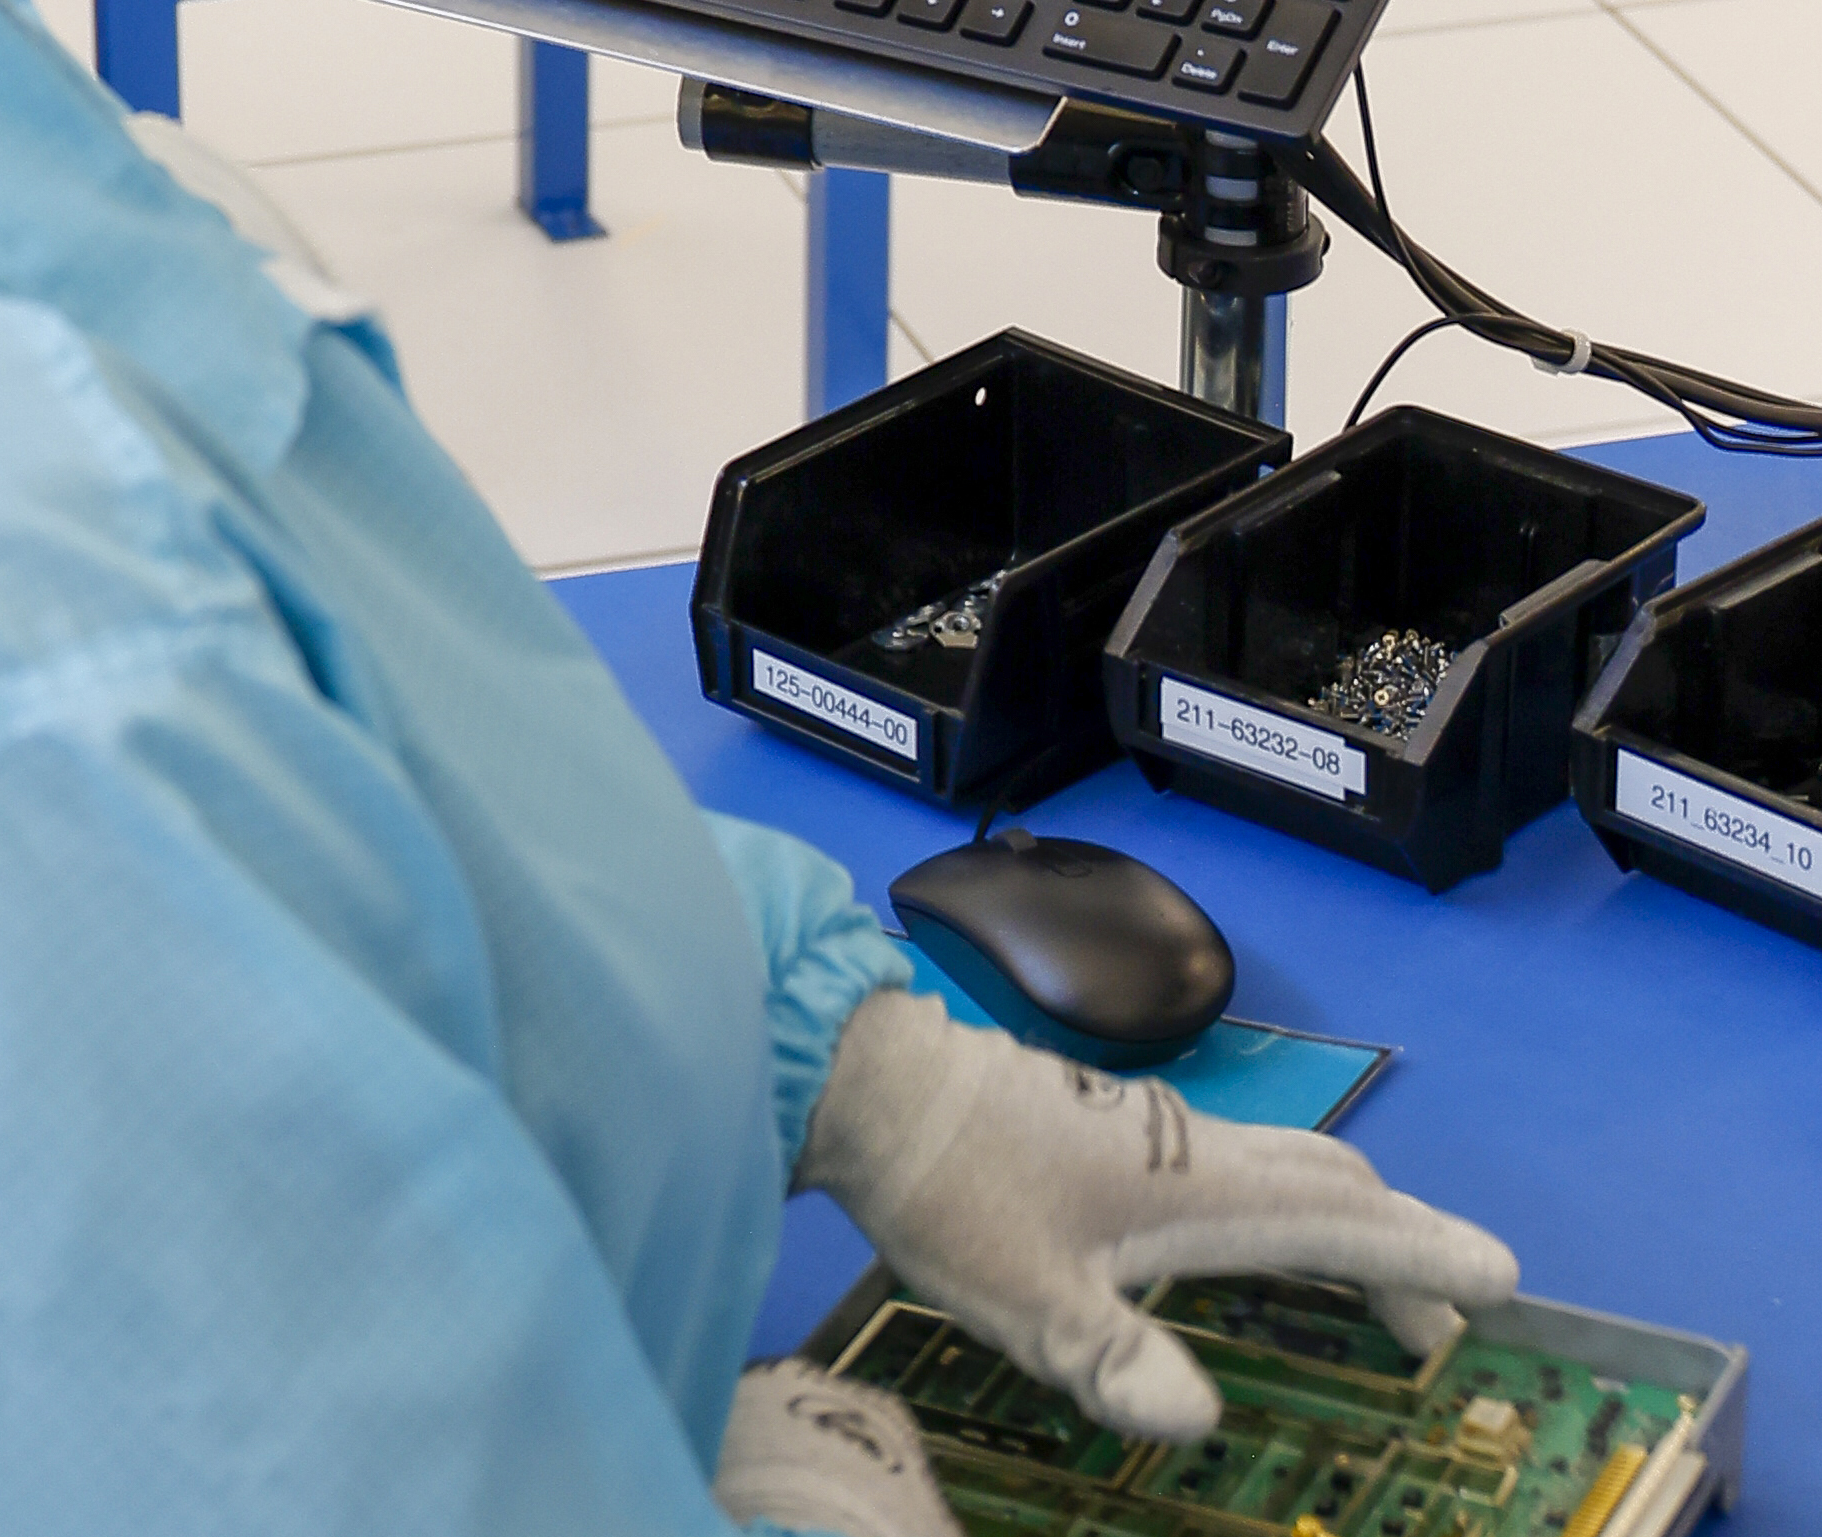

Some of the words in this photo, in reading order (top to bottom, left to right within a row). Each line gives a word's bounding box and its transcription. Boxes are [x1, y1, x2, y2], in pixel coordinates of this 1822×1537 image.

[1064, 10, 1080, 27] 0
[1052, 32, 1087, 51] Insert
[1266, 39, 1299, 56] Enter
[1180, 61, 1219, 81] Delete
[764, 665, 908, 746] 125-00444-00
[1175, 698, 1341, 777] 211-63232-08
[1649, 784, 1814, 872] 211_63234_10
